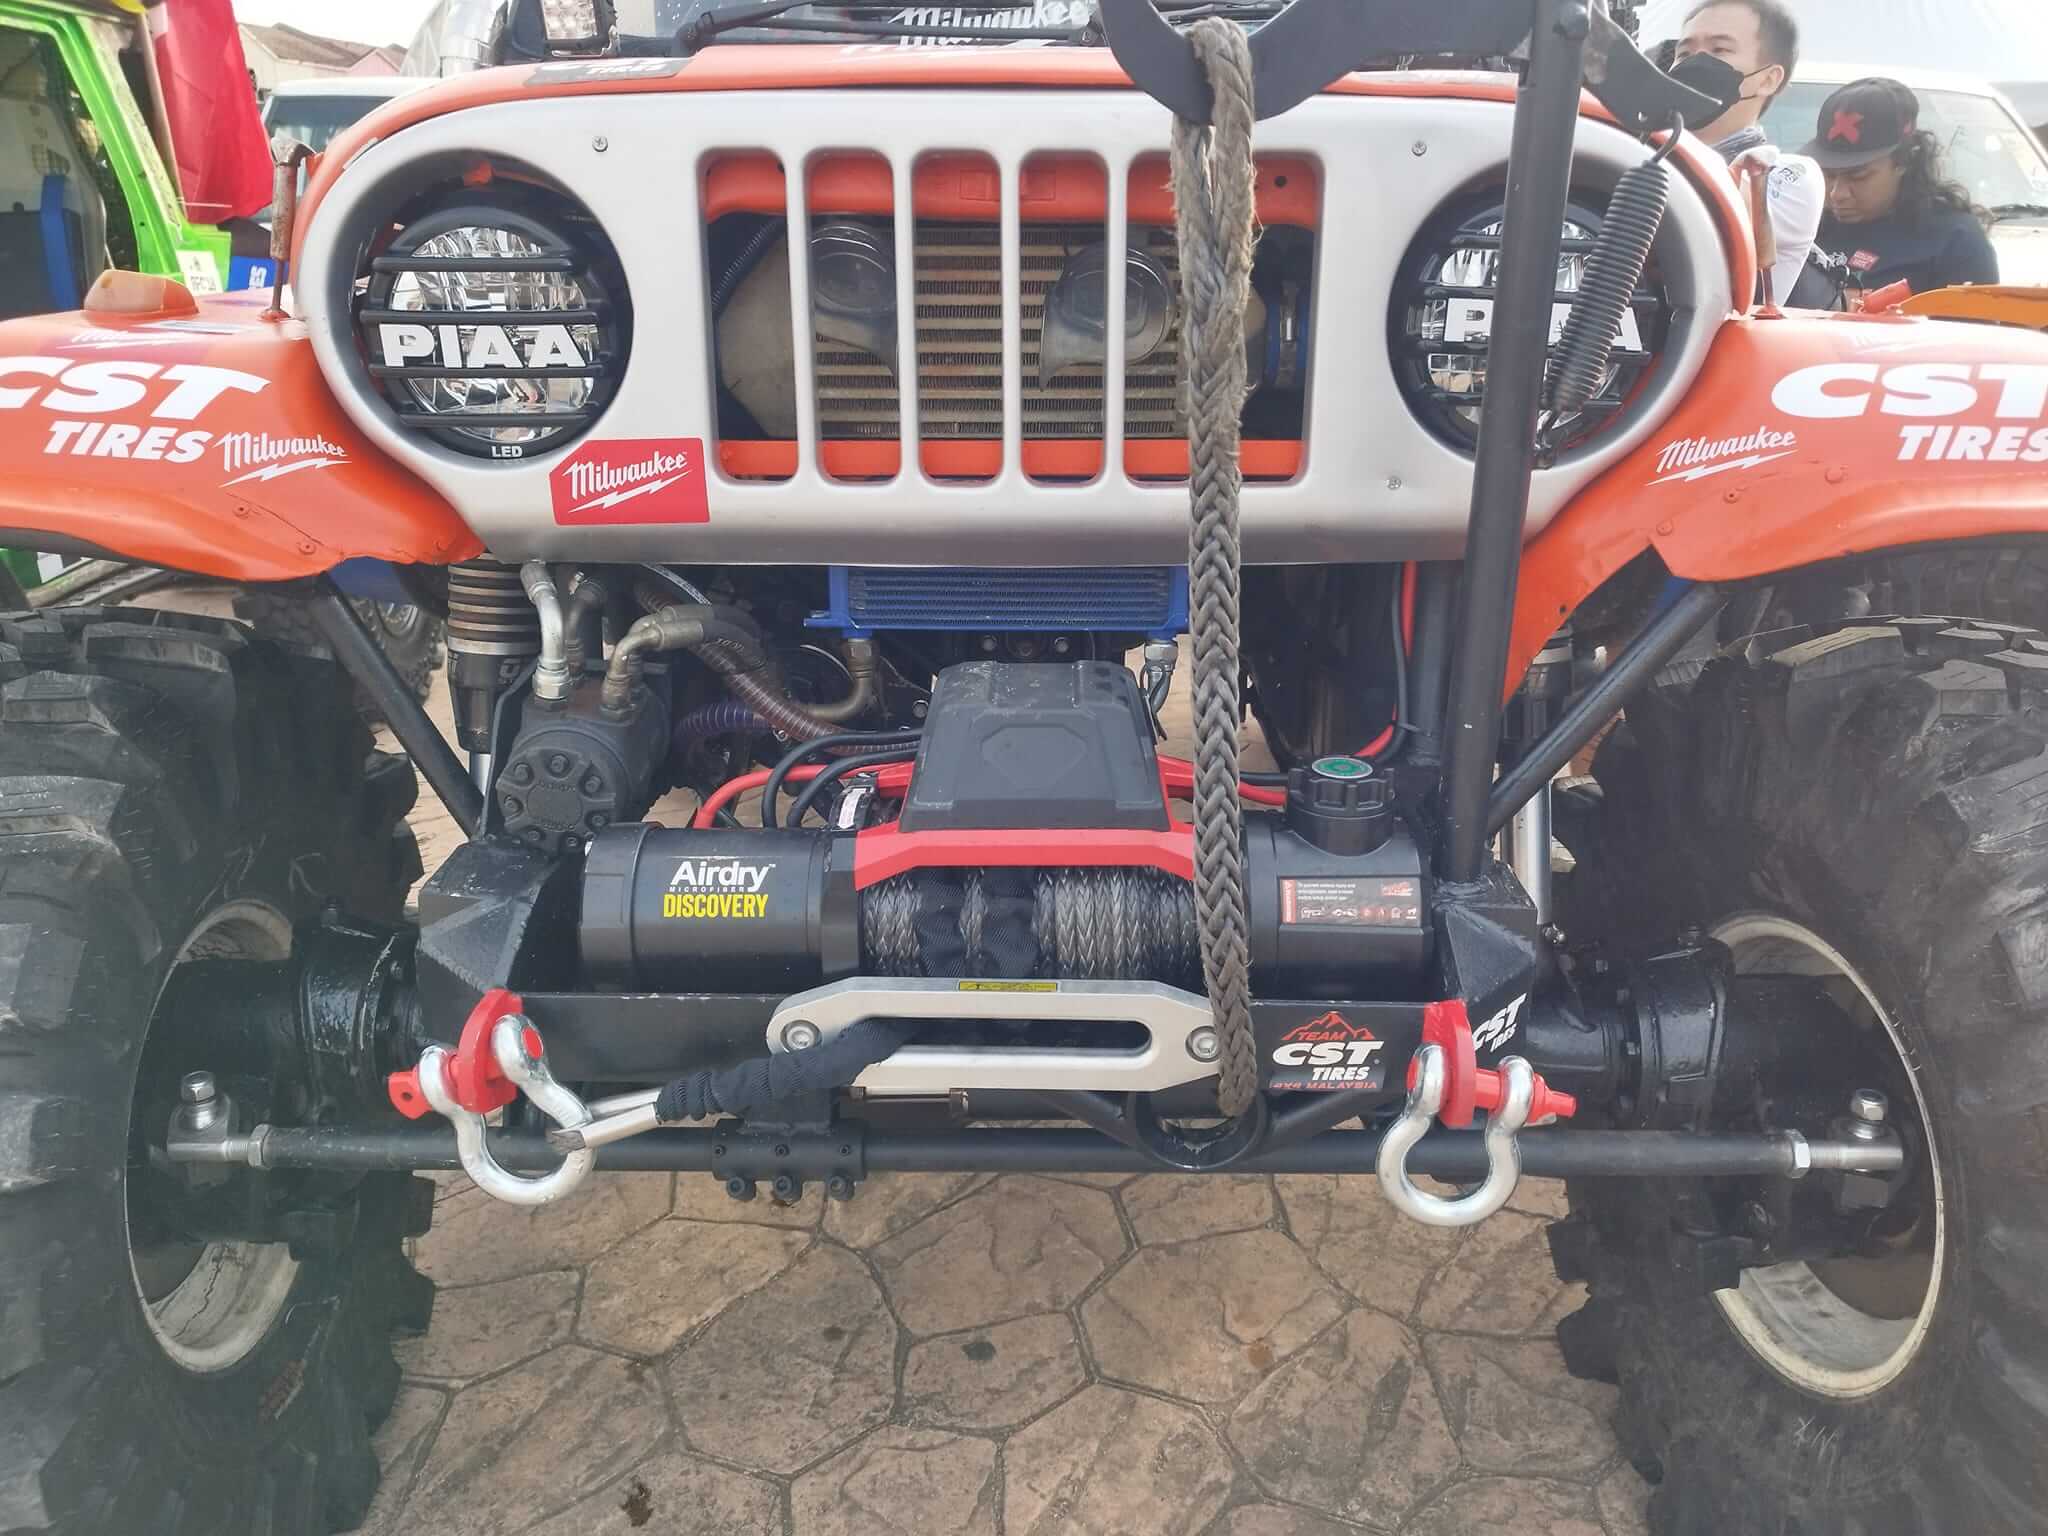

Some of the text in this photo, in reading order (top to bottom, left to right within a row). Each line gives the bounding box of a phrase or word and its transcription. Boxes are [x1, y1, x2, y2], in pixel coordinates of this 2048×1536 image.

[379, 323, 588, 369] PIAA
[0, 355, 272, 421] CST
[1771, 362, 2048, 419] CST
[43, 420, 215, 463] TIRES
[211, 431, 349, 472] Milwaukee
[491, 445, 523, 458] LED
[1655, 425, 1797, 474] Milwaukee
[1896, 424, 2048, 462] TIRES
[562, 450, 689, 500] Milwaukee
[662, 893, 770, 918] DISCOVERY
[1298, 1031, 1348, 1041] TEAM
[1471, 992, 1528, 1051] CST
[1272, 1040, 1385, 1066] CST
[1312, 1066, 1371, 1081] TIRES
[1306, 1081, 1378, 1089] MALAYSIA
